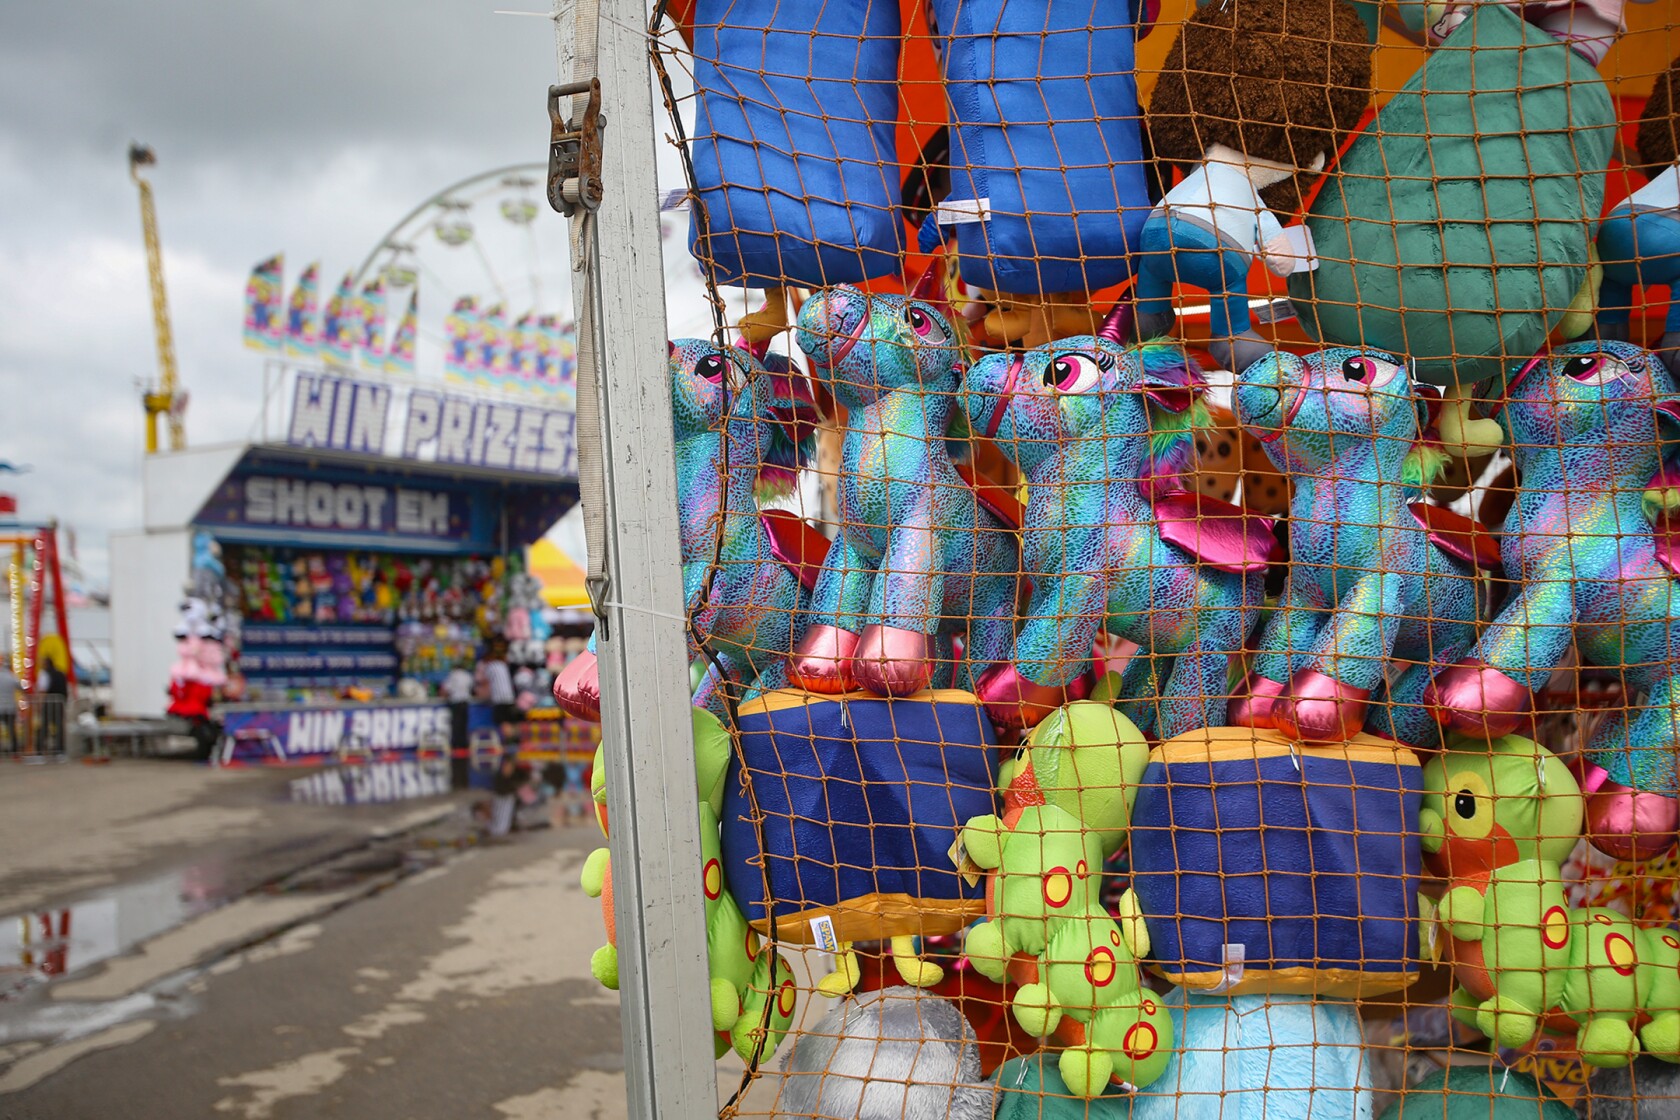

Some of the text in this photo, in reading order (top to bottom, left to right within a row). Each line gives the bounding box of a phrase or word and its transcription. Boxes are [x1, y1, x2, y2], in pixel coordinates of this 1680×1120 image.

[290, 372, 390, 453] WIN
[245, 476, 387, 530] SHOOT
[286, 706, 450, 754] WIN PRIZES
[820, 921, 835, 951] SPAM
[1517, 1057, 1593, 1083] PAM
